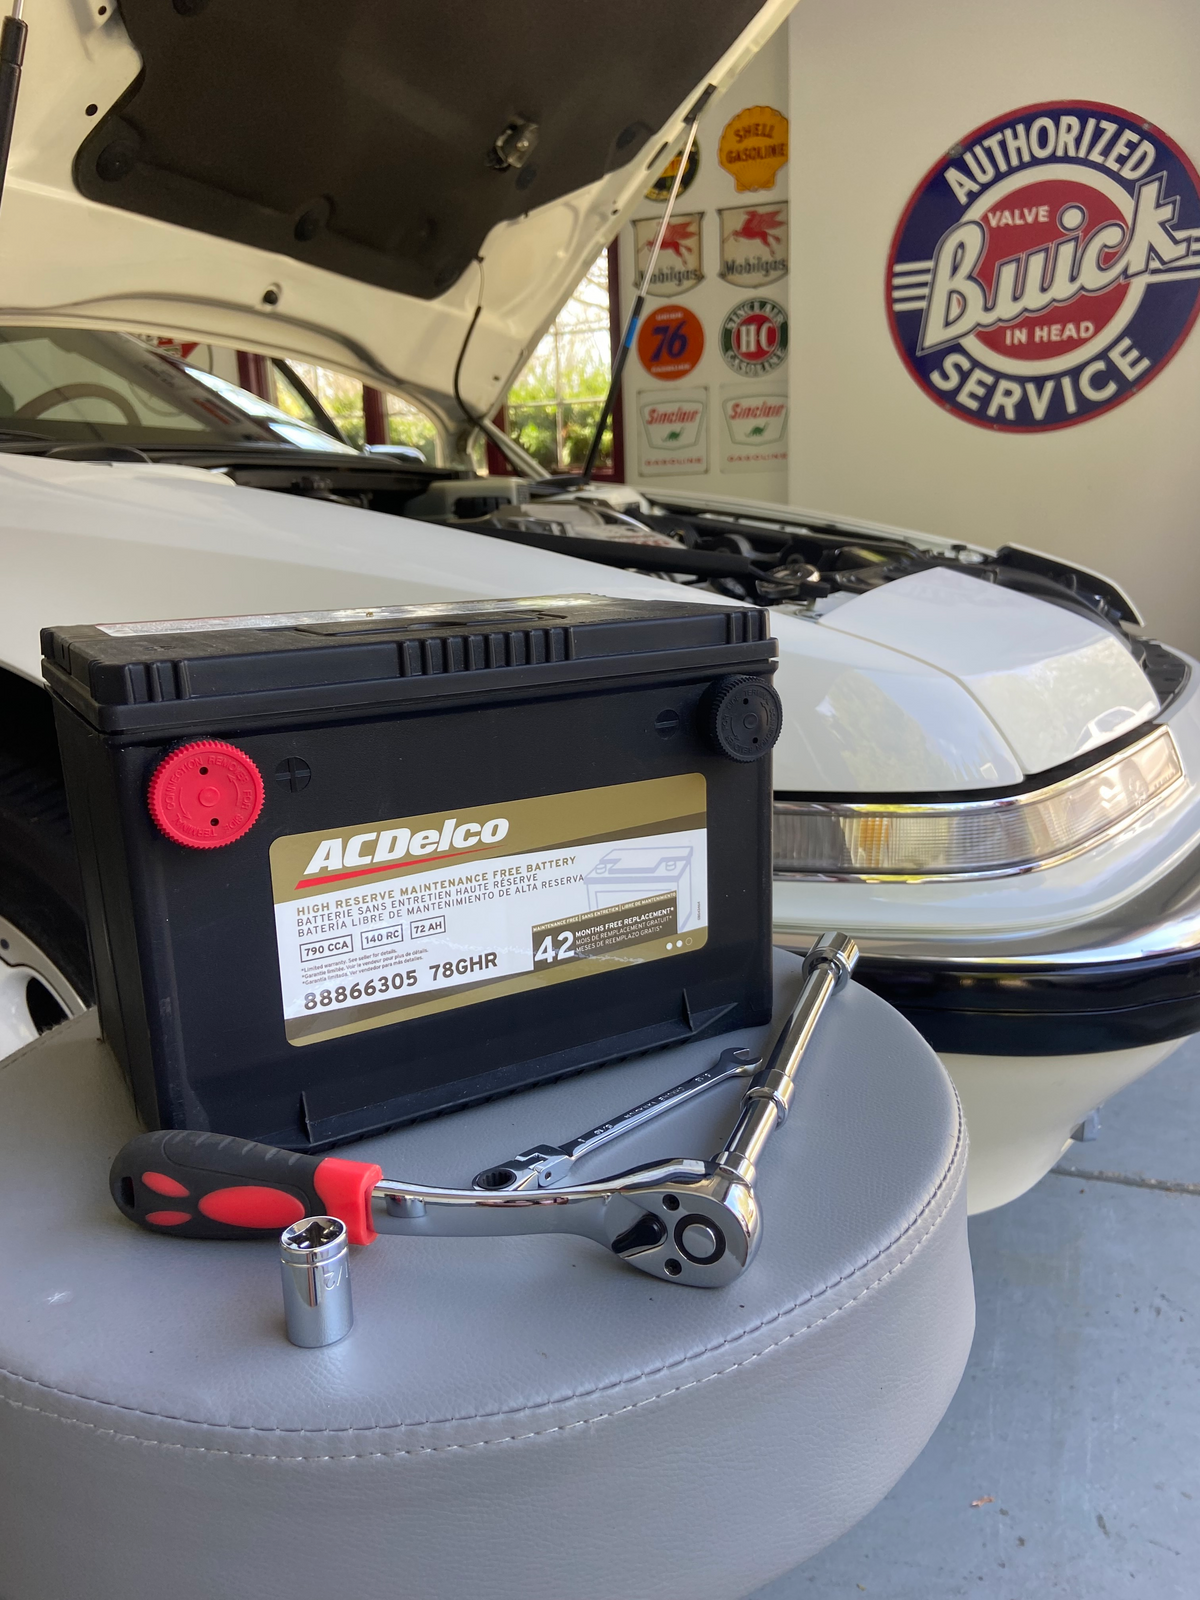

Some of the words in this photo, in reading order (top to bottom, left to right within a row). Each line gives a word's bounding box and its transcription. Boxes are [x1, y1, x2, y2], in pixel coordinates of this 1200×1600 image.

[733, 123, 775, 144] SHELL
[726, 142, 785, 164] GASOLINE
[943, 115, 1157, 205] AUTHORIZED
[987, 205, 1050, 228] VALVE
[724, 255, 786, 277] Mobilgas
[916, 170, 1191, 356] Buick
[725, 301, 784, 328] SINCLAIR
[650, 320, 688, 362] 76
[1005, 329, 1028, 346] IN
[1035, 321, 1095, 343] HEAD
[929, 336, 1151, 421] SERVICE
[646, 406, 699, 425] Sinclair
[729, 401, 785, 420] Sinclair
[303, 818, 509, 875] ACDelco
[297, 902, 330, 916] HIGH
[336, 890, 395, 910] RESERVE
[400, 873, 489, 898] MAINTENANCE
[493, 866, 522, 880] FREE
[526, 856, 577, 874] BATTERY
[297, 909, 353, 927] BATTERIE
[357, 902, 388, 916] SANS
[391, 890, 452, 909] ENTRETIEN
[456, 882, 489, 897] HAUTE
[493, 873, 538, 889] RÉSERVE
[298, 920, 347, 937] BATERÍA
[352, 913, 384, 927] LIBRE
[389, 908, 402, 919] DE
[407, 891, 494, 916] MANTENIMIENTO
[498, 888, 511, 898] DE
[515, 882, 538, 895] ALTA
[541, 874, 584, 890] RESERVA
[621, 902, 634, 910] LIBRE
[414, 925, 426, 934] 72
[428, 921, 442, 932] AH
[533, 919, 566, 932] MAINTENANCE
[566, 916, 579, 924] FREE
[581, 912, 594, 920] SANS
[365, 932, 383, 945] 140
[386, 929, 400, 940] RC
[575, 924, 604, 938] MONTHS
[605, 920, 623, 929] FREE
[575, 935, 591, 945] MOIS
[591, 932, 600, 941] DE
[600, 922, 645, 938] REMPLACEMENT
[304, 945, 325, 957] 790
[327, 940, 349, 952] CCA
[534, 930, 575, 963] 42
[576, 941, 596, 952] MESES
[596, 939, 604, 948] DE
[605, 931, 640, 945] REEMPLAZO
[304, 969, 418, 1010] 88866305
[429, 952, 498, 981] 78GHR
